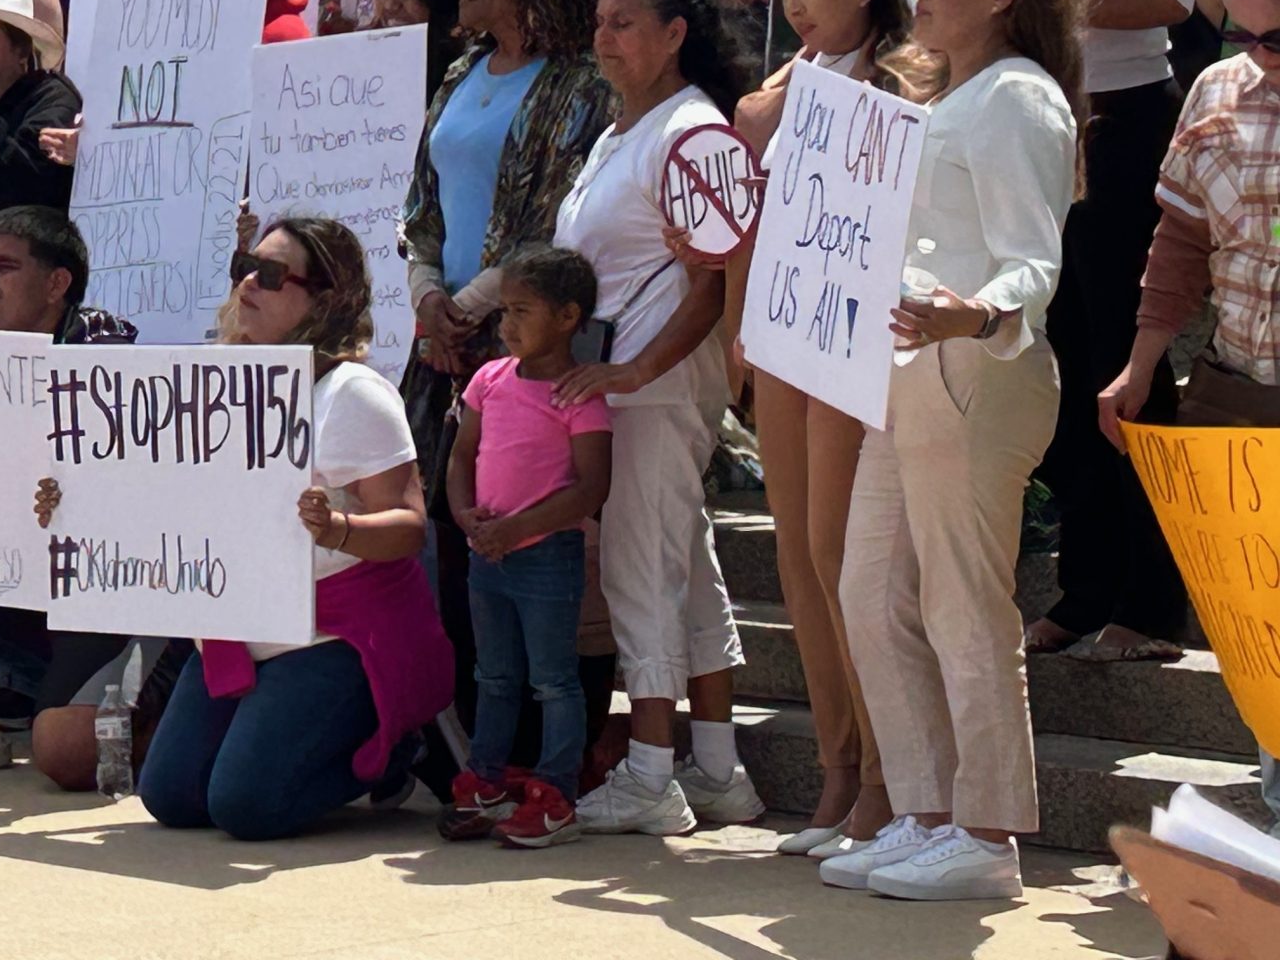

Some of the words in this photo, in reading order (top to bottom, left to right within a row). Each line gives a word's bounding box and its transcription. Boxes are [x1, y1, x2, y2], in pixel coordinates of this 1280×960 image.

[117, 55, 189, 123] NOT
[796, 172, 872, 277] Deport
[1227, 436, 1264, 514] IS
[1235, 532, 1280, 591] TO
